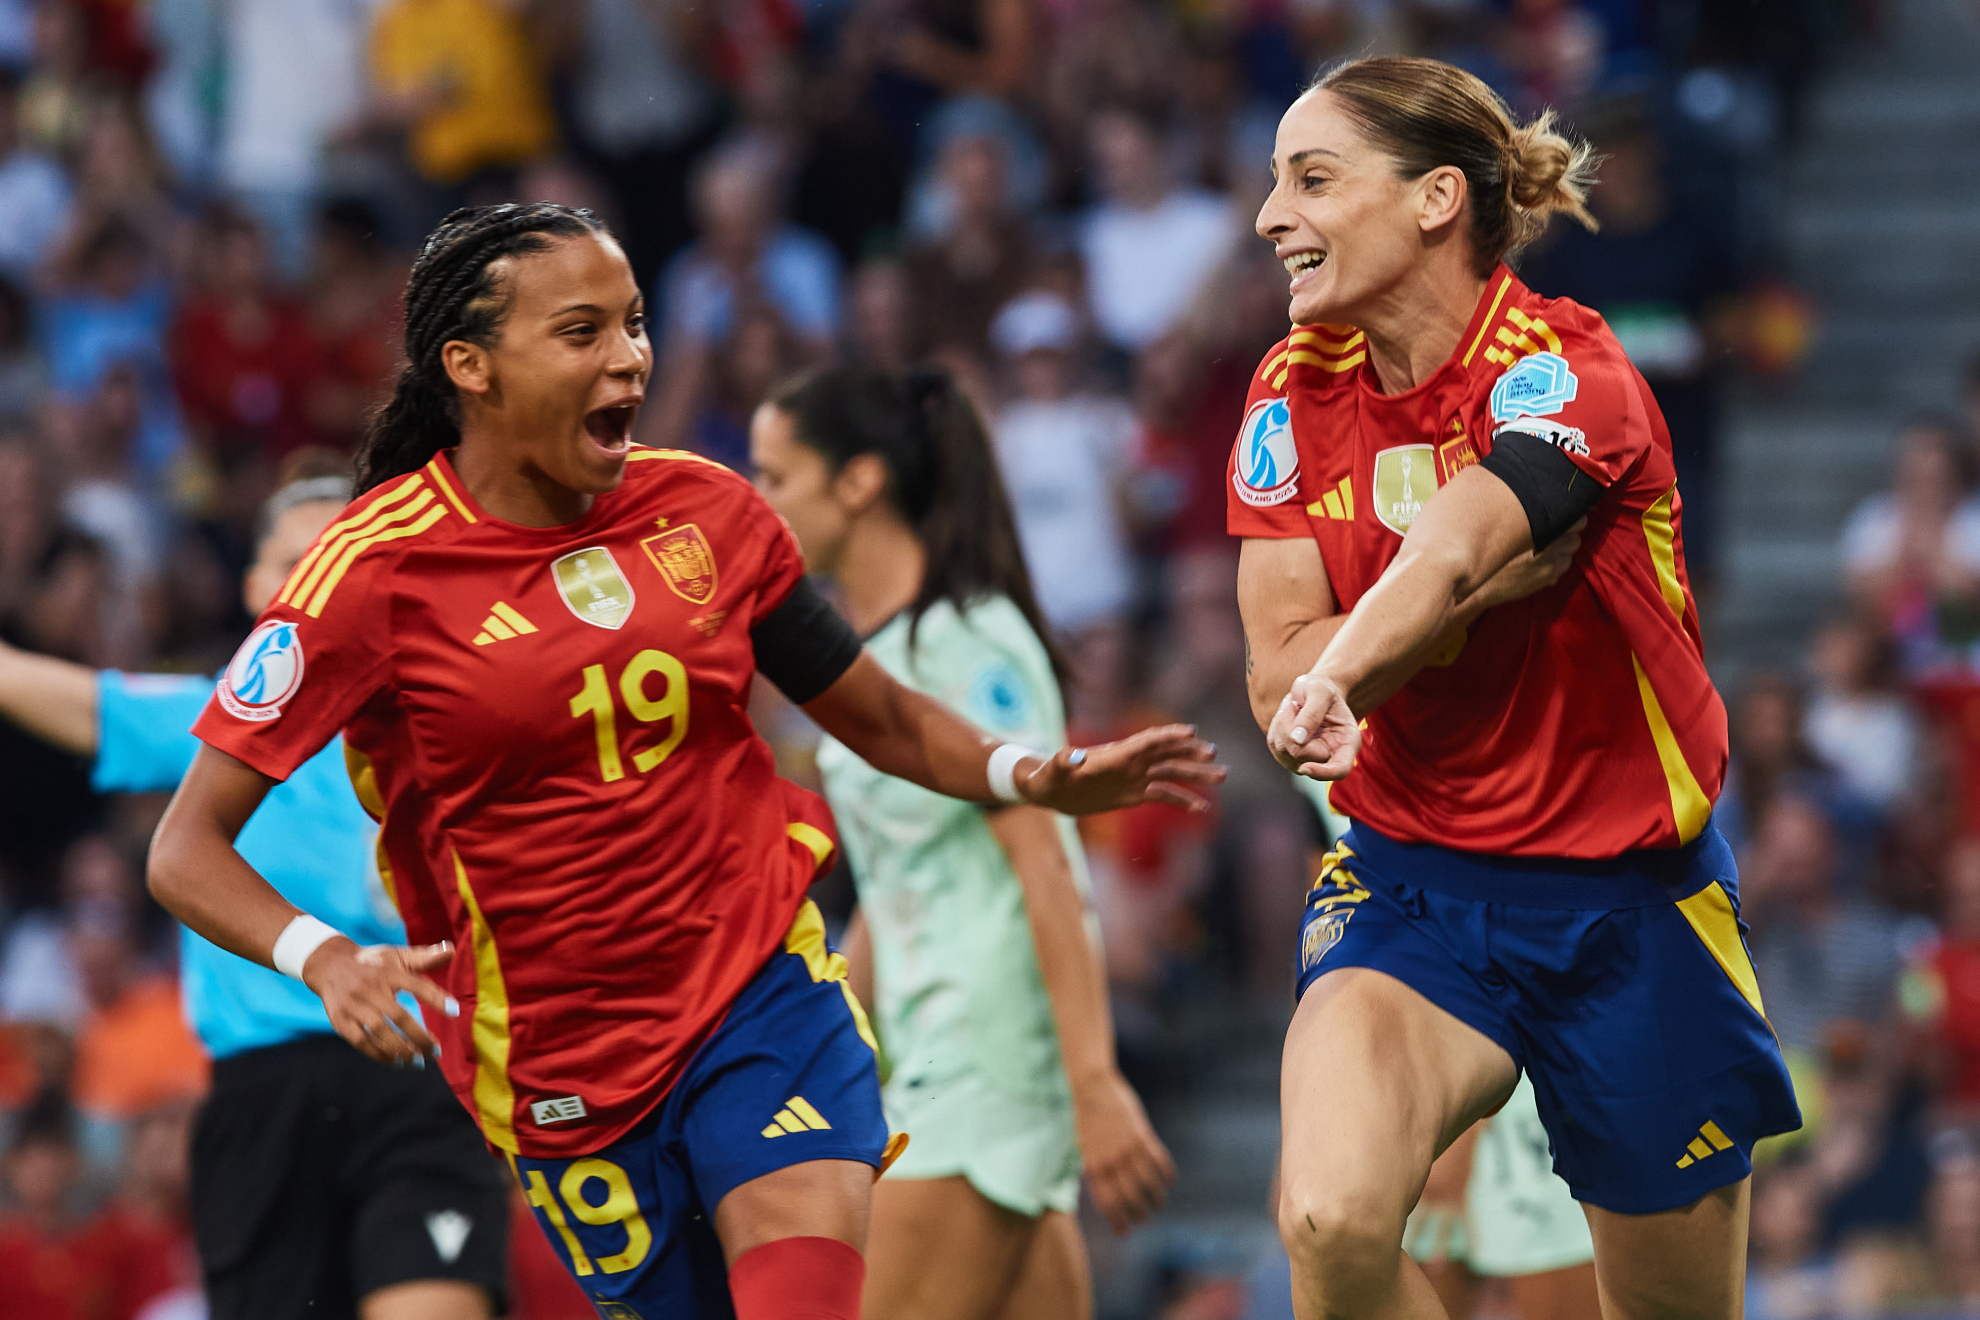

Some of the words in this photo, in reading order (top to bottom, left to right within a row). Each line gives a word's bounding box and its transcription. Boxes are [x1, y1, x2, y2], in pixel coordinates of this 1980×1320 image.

[1274, 486, 1293, 501] 2025
[1392, 501, 1422, 516] FIFA
[587, 597, 620, 612] FIFA
[569, 649, 690, 782] 19
[525, 1157, 652, 1276] 19
